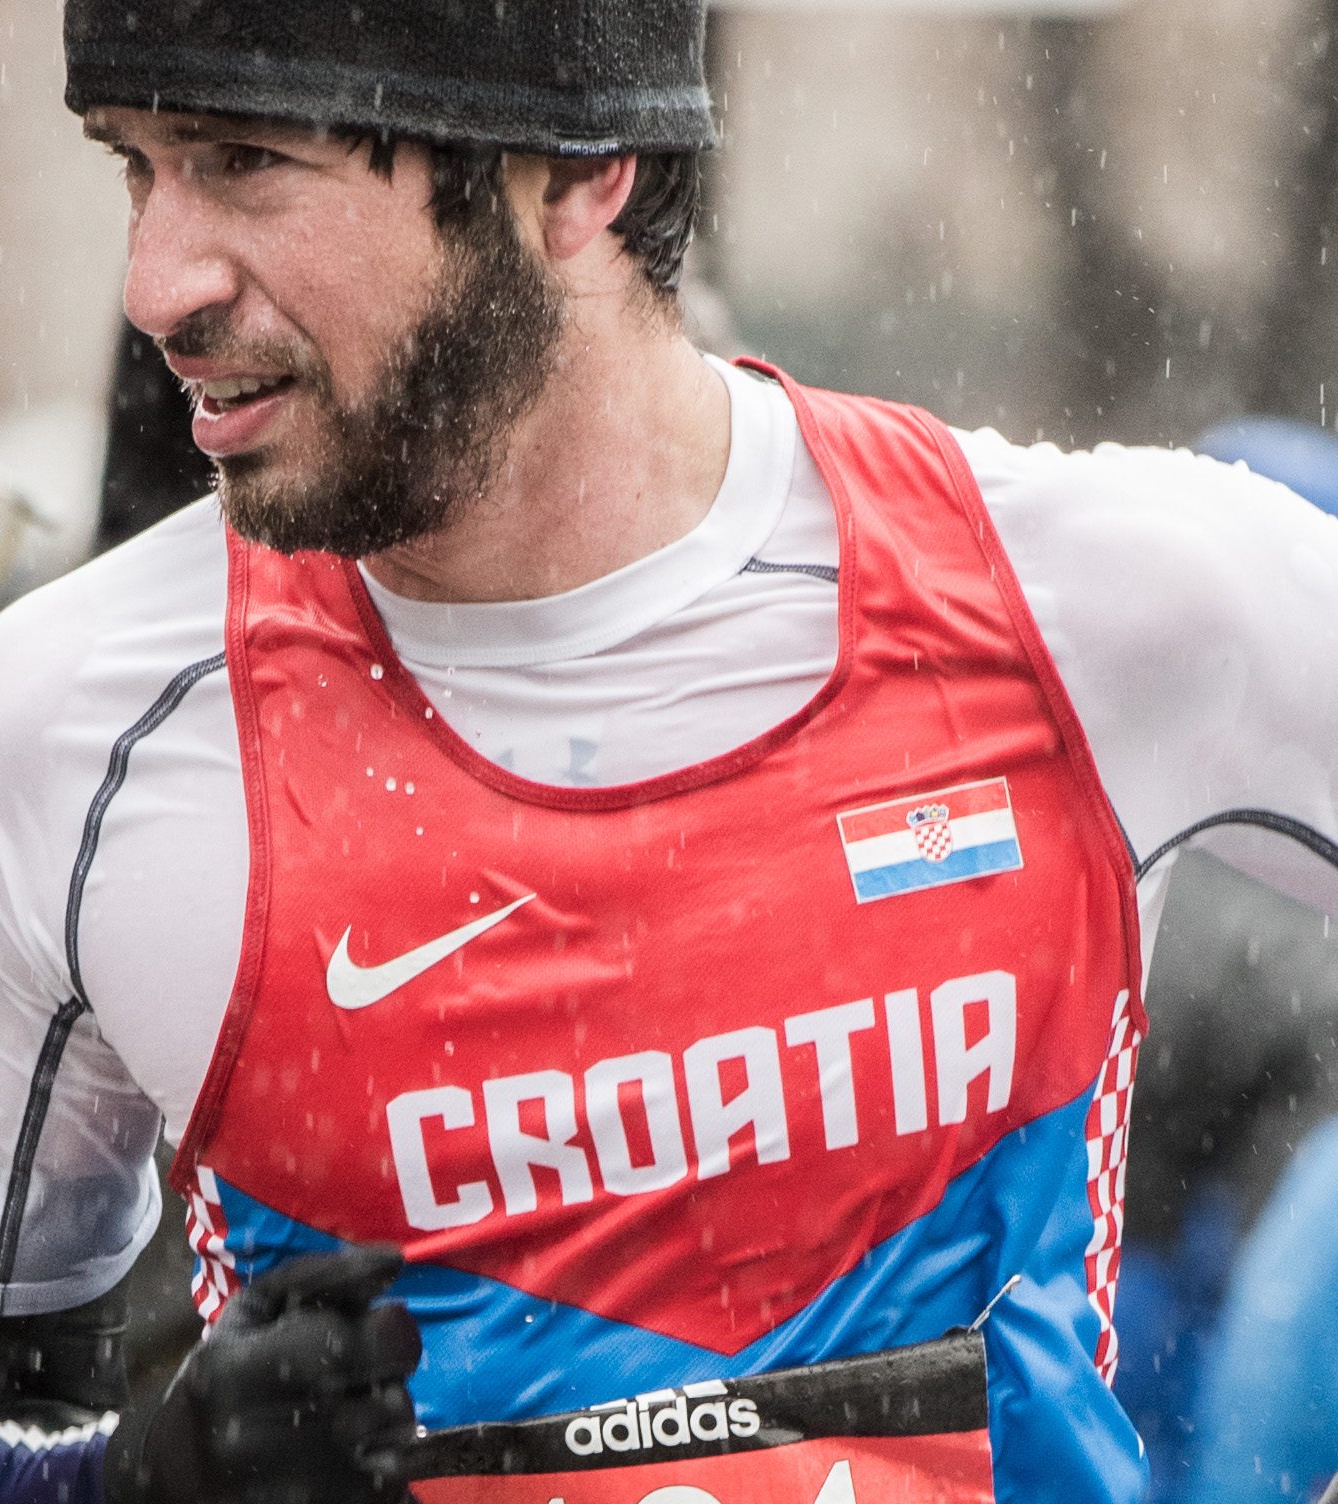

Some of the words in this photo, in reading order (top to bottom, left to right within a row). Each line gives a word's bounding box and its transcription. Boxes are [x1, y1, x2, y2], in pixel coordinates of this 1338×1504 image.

[559, 141, 619, 155] climawarm
[386, 969, 1017, 1232] CROATIA
[565, 1396, 761, 1457] adidas
